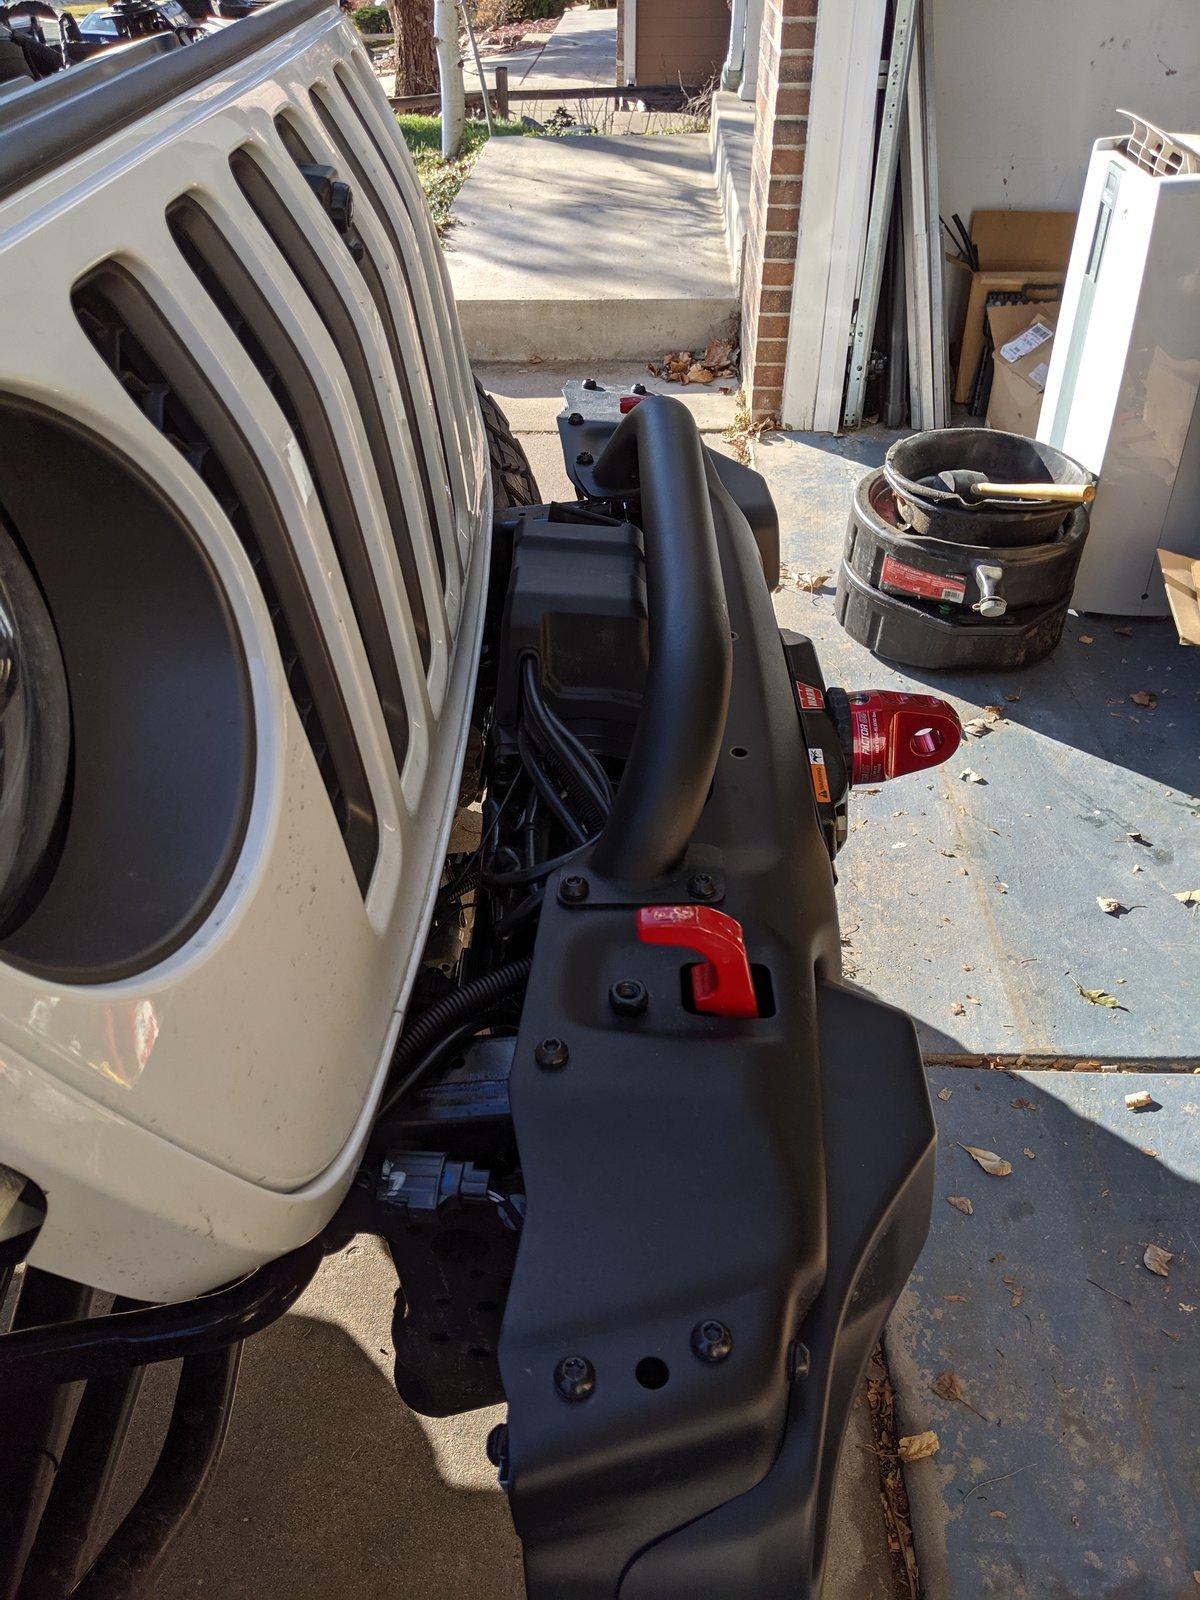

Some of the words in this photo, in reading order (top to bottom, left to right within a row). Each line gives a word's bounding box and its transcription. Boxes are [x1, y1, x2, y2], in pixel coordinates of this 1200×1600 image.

[805, 687, 817, 706] WARN
[860, 724, 870, 755] FACTOR
[816, 768, 824, 790] WARNING
